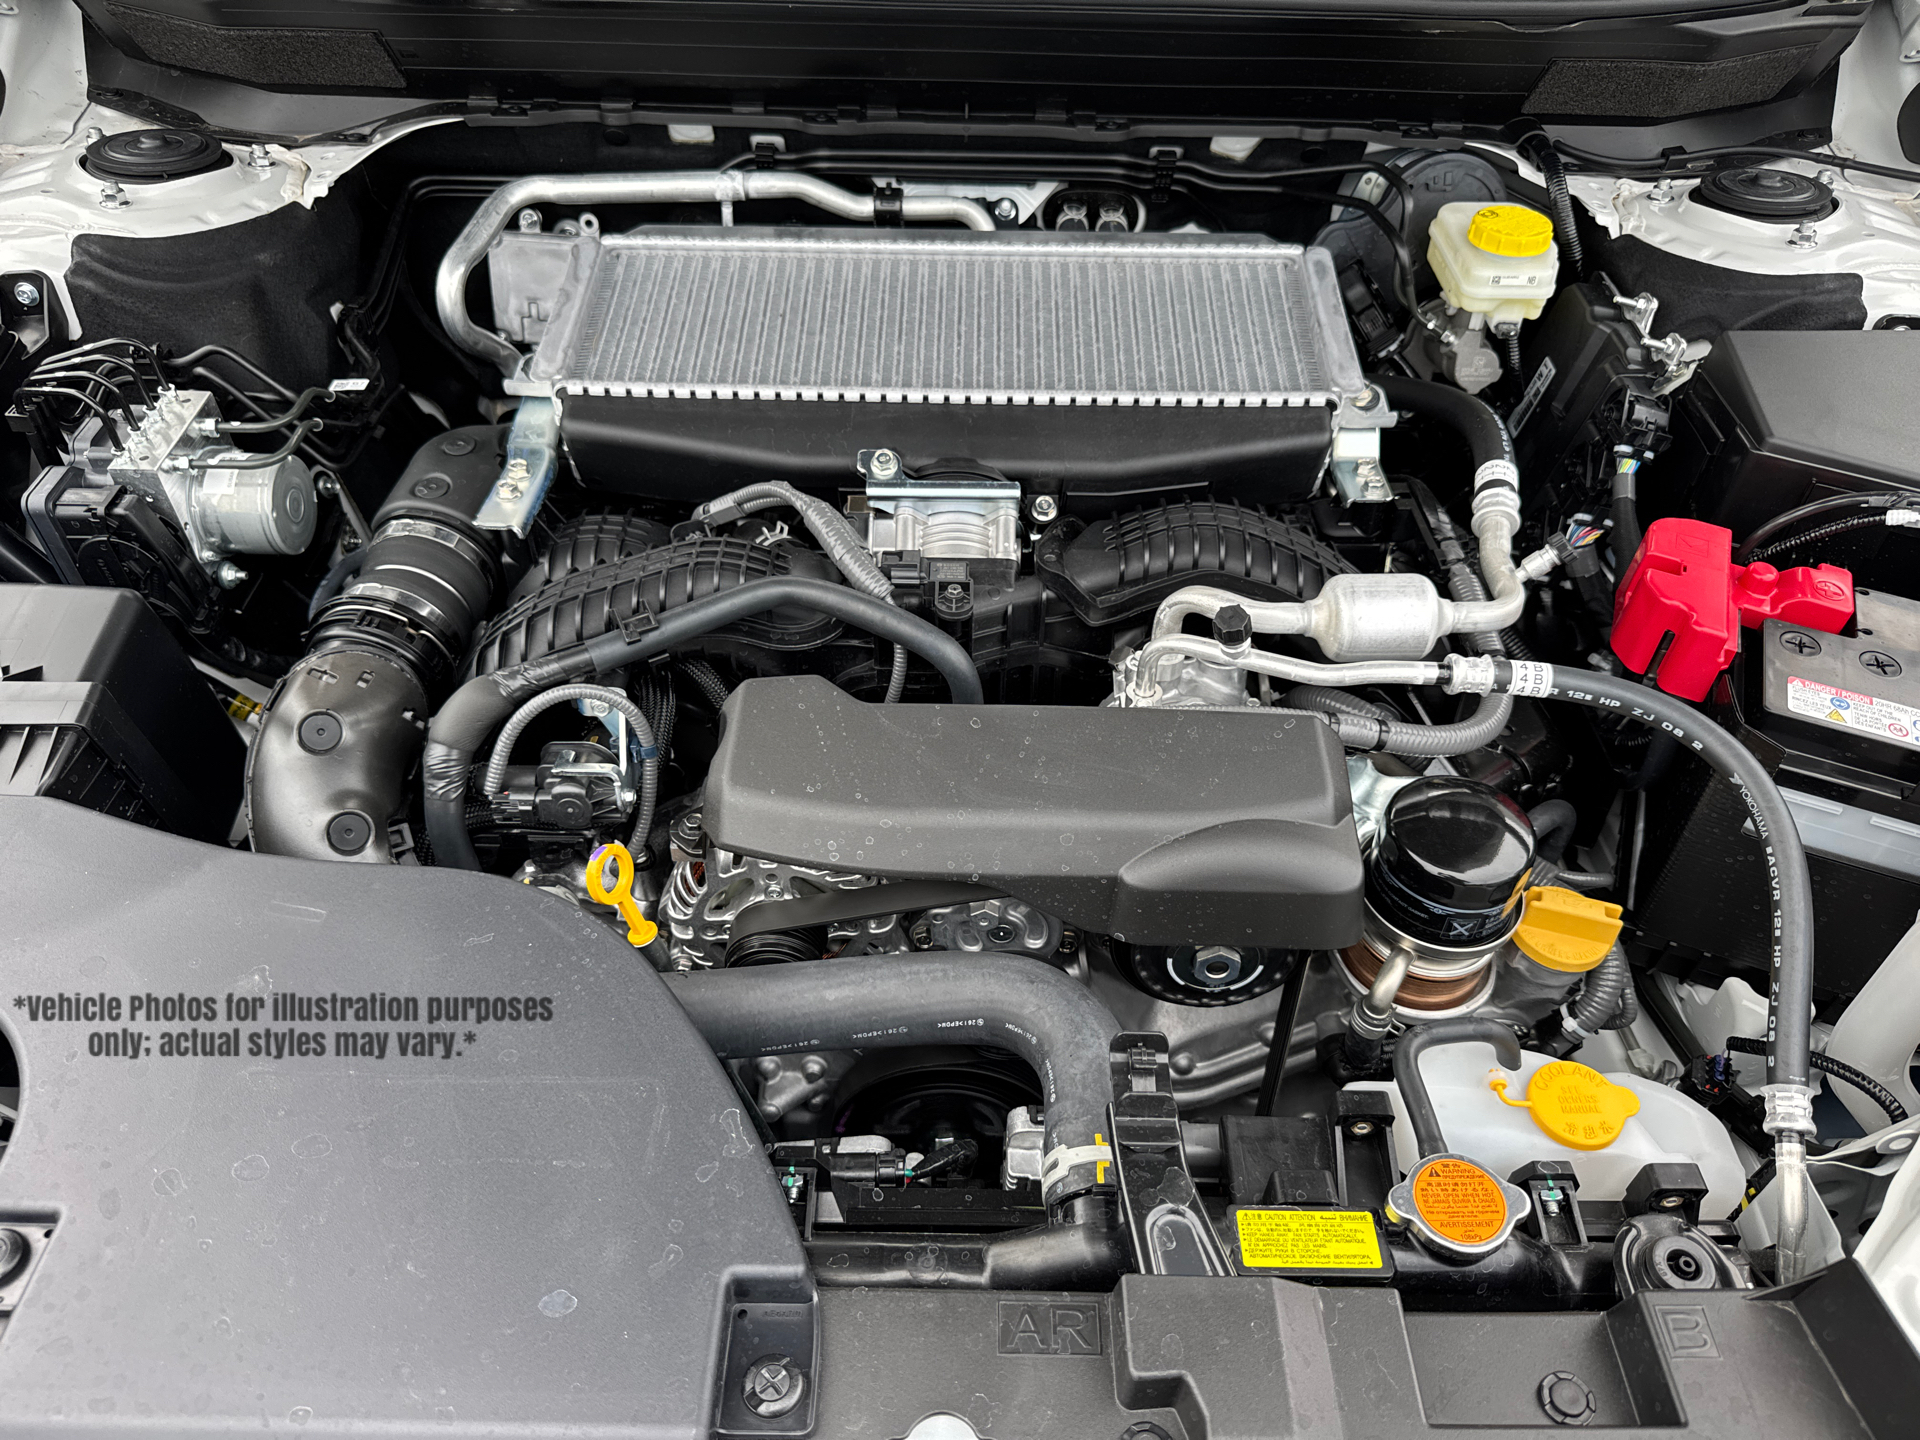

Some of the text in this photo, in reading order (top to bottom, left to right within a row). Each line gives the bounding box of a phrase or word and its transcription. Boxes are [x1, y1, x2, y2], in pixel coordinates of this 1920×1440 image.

[1520, 662, 1544, 672] 4 B
[1520, 674, 1544, 684] 4 B
[1516, 686, 1526, 694] 4
[1530, 686, 1541, 696] B
[1804, 681, 1836, 696] DANGER
[1842, 690, 1870, 704] POISON
[1599, 697, 1620, 708] HP
[1632, 708, 1656, 722] ZJ
[1661, 722, 1684, 738] 08
[1692, 740, 1704, 750] 2
[1738, 786, 1769, 840] YOKOHAMA
[1774, 945, 1781, 968] HP
[1771, 982, 1779, 1006] ZJ
[1769, 1016, 1776, 1042] 08
[1768, 1055, 1775, 1067] 2
[1534, 1064, 1609, 1090] COOLANT
[1560, 1085, 1580, 1094] SEE
[1560, 1105, 1602, 1114] MANUAL
[1006, 1305, 1092, 1348] AR
[1660, 1311, 1710, 1352] B
